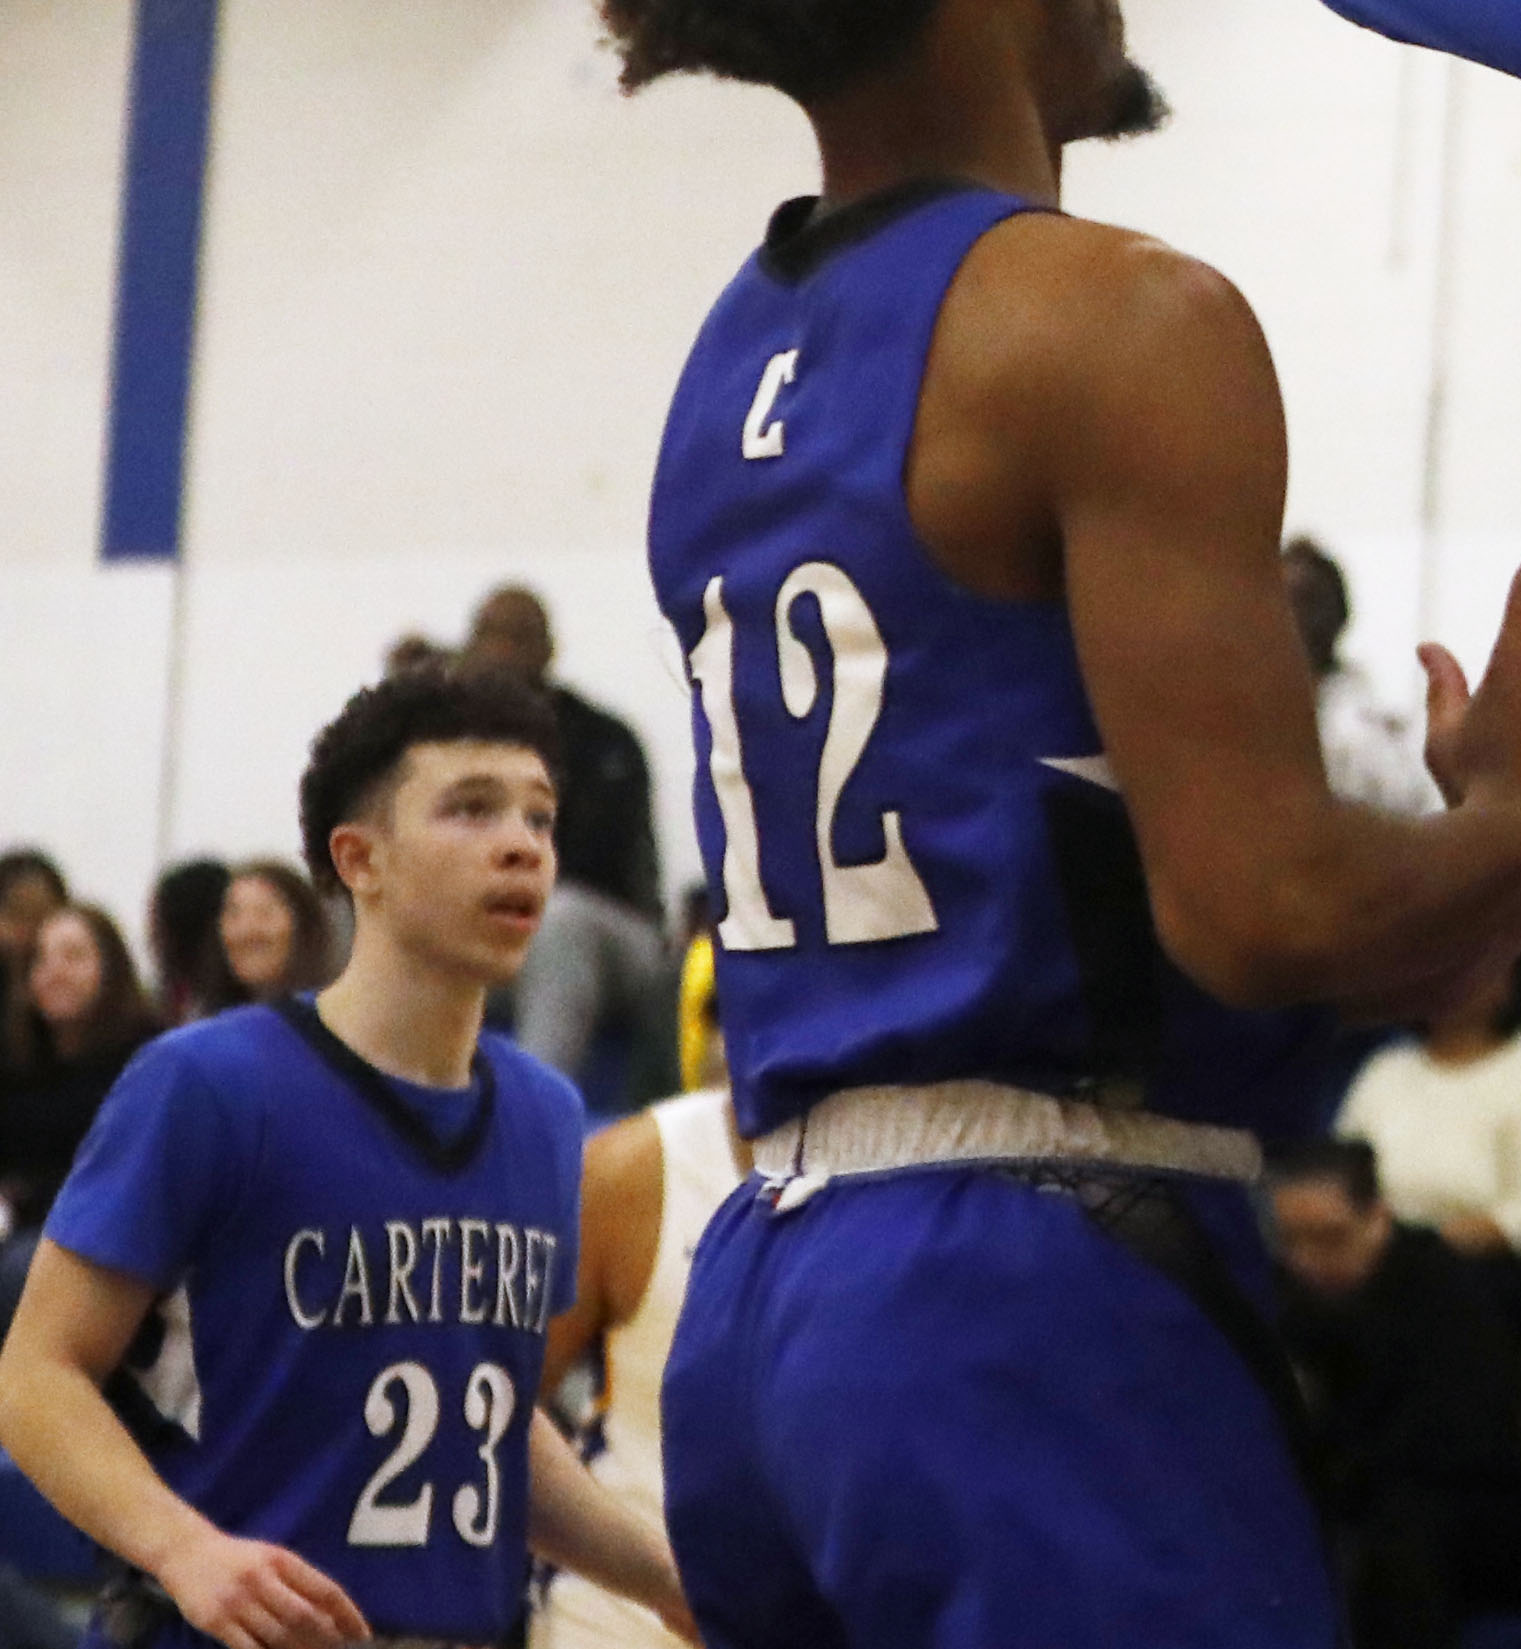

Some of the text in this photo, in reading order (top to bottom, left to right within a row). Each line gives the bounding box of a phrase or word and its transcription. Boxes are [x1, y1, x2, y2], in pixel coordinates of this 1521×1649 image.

[741, 347, 800, 461] C
[689, 560, 939, 952] 12
[284, 1216, 558, 1335] CARTERET
[347, 1360, 516, 1548] 23
